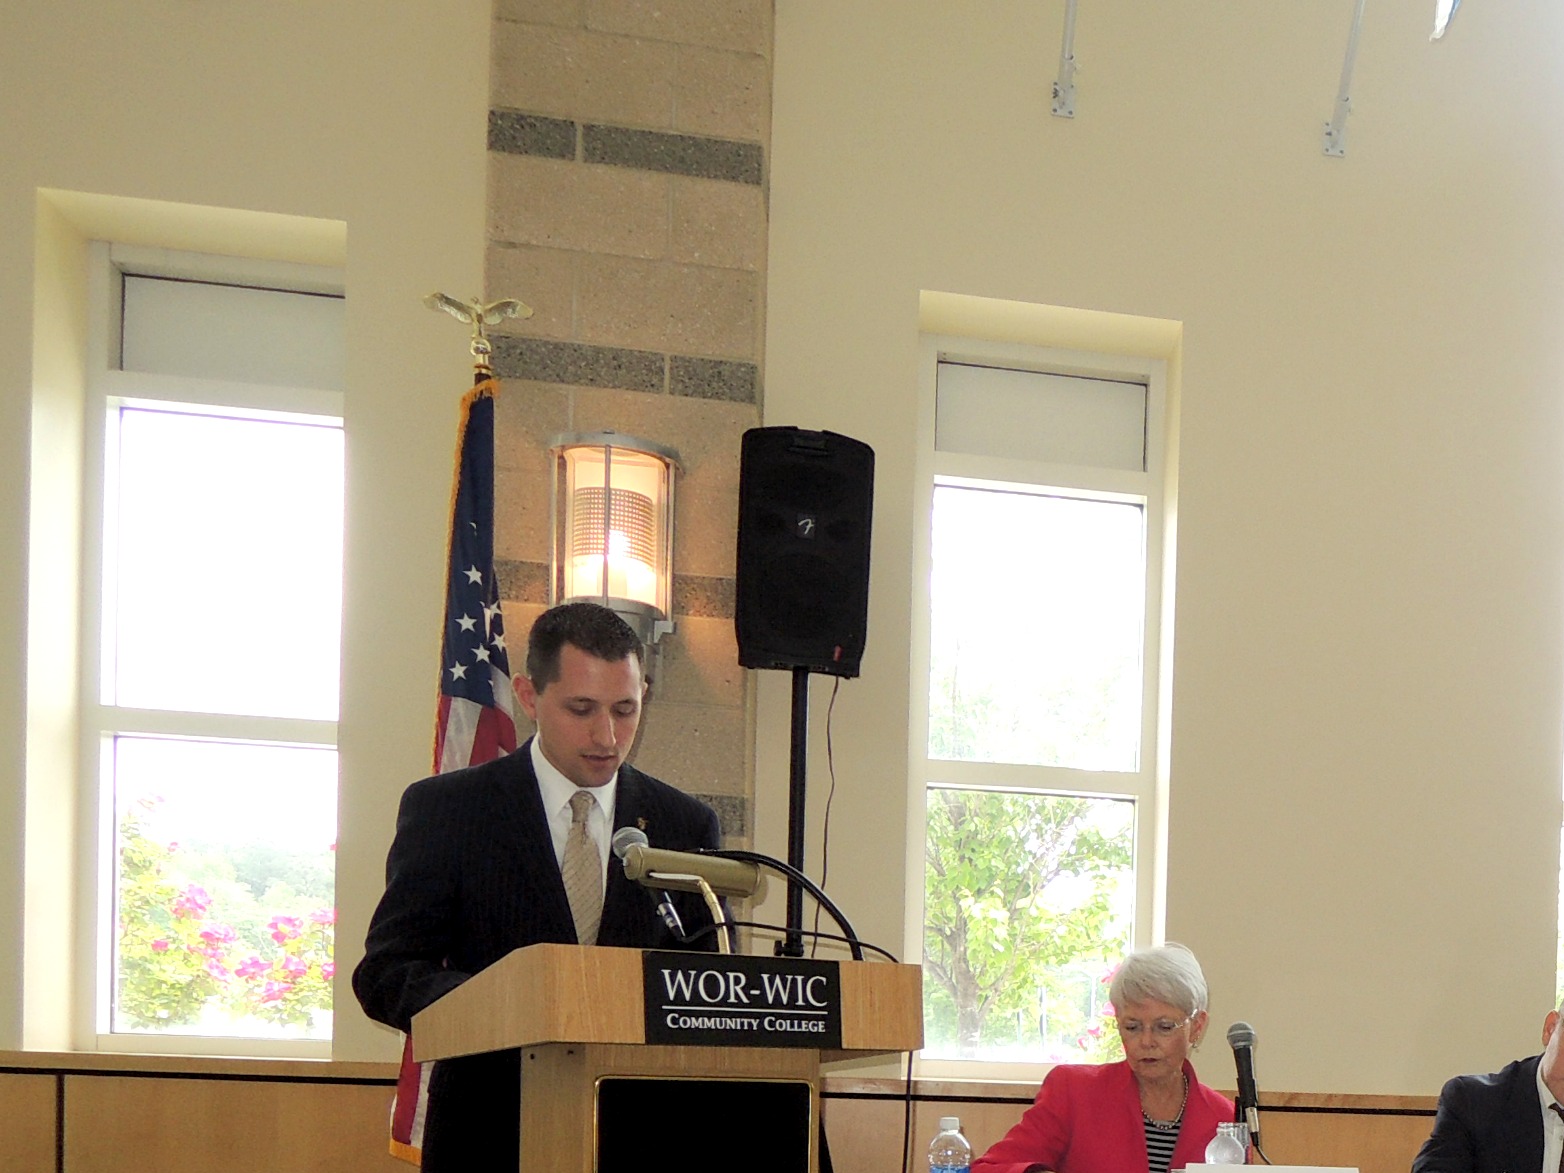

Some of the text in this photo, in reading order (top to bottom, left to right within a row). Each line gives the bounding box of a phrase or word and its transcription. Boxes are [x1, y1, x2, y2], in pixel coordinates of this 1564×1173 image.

[661, 969, 828, 1007] WOR-WIC
[666, 1013, 826, 1032] COMMUNITY COLLEGE
